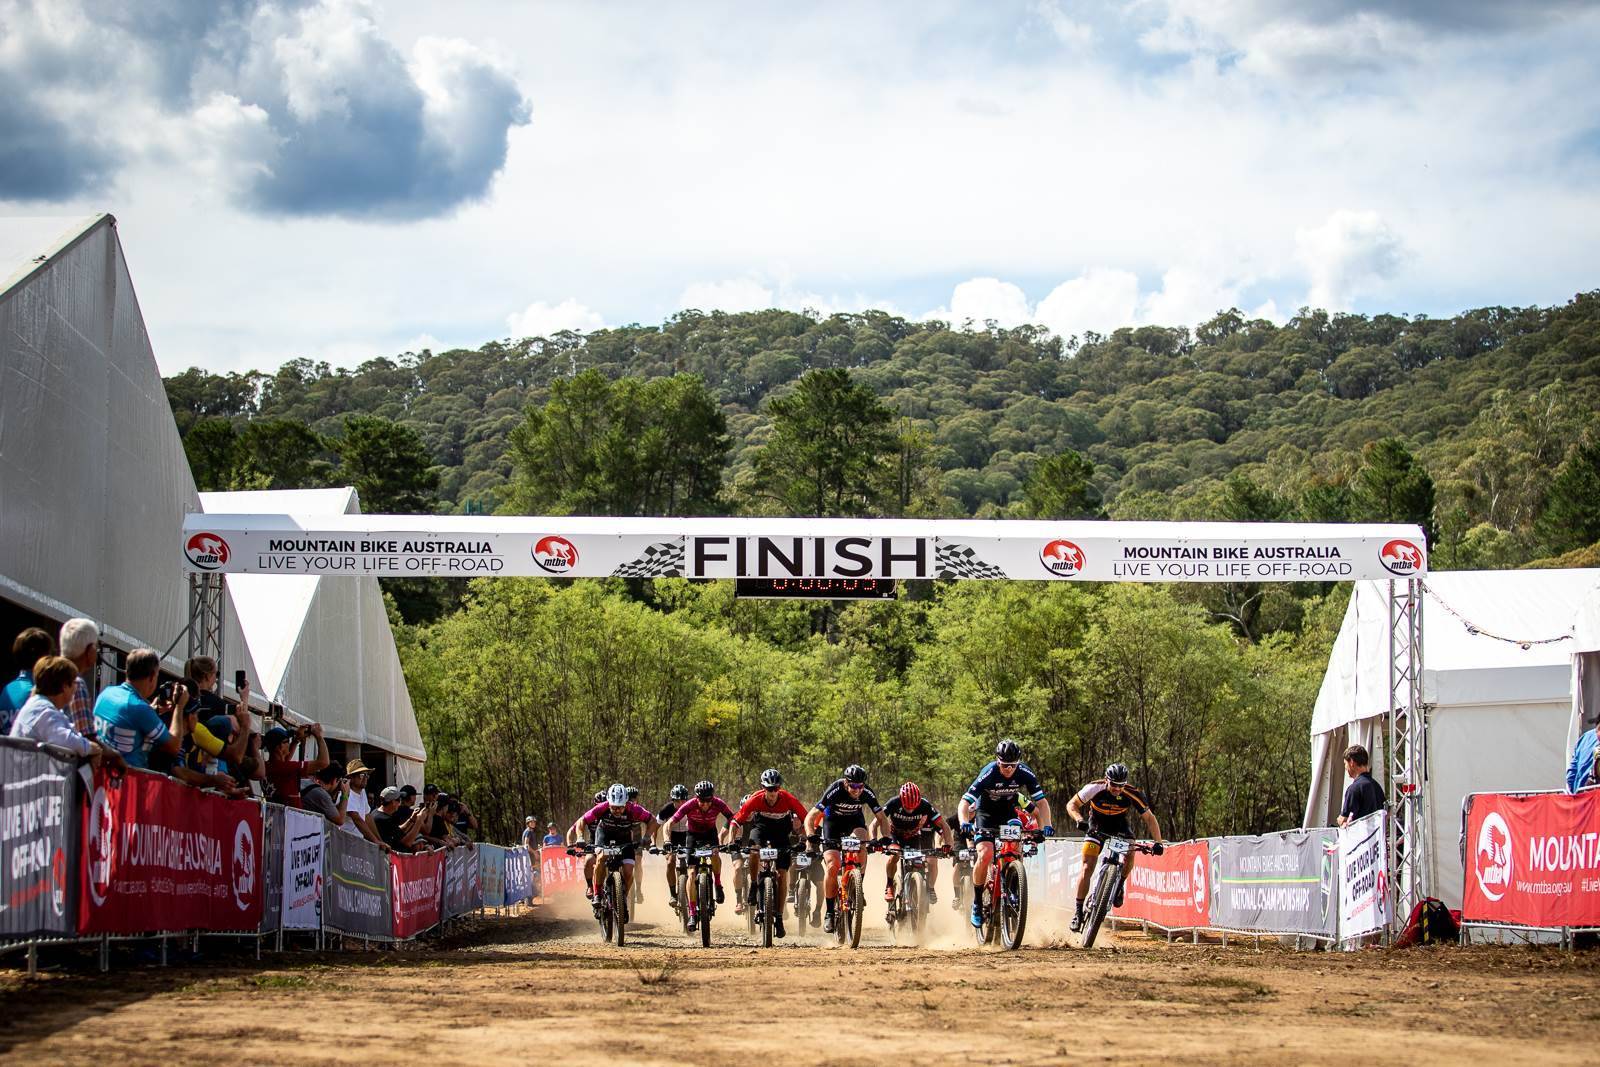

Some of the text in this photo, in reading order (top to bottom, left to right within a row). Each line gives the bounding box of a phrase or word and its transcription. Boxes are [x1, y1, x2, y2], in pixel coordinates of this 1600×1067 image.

[269, 539, 493, 554] MOUNTAIN BIKE AUSTRALIA
[1124, 546, 1341, 559] MOUNTAIN BIKE AUSTRALIA
[195, 553, 219, 563] mtba
[258, 555, 504, 571] LIVE YOUR LIFE OFF-ROAD
[543, 557, 567, 567] mtba
[694, 536, 926, 577] FINISH
[1051, 561, 1075, 571] mtba
[1113, 562, 1353, 576] LIVE YOUR LIFE OFF-ROAD
[1390, 560, 1413, 570] mtba
[1346, 860, 1356, 883] LIVE
[1357, 850, 1369, 873] YOUR
[1516, 878, 1600, 896] www.mtba.org.au #Live
[1231, 888, 1310, 912] NATIONAL CHAMPIONSHIPS
